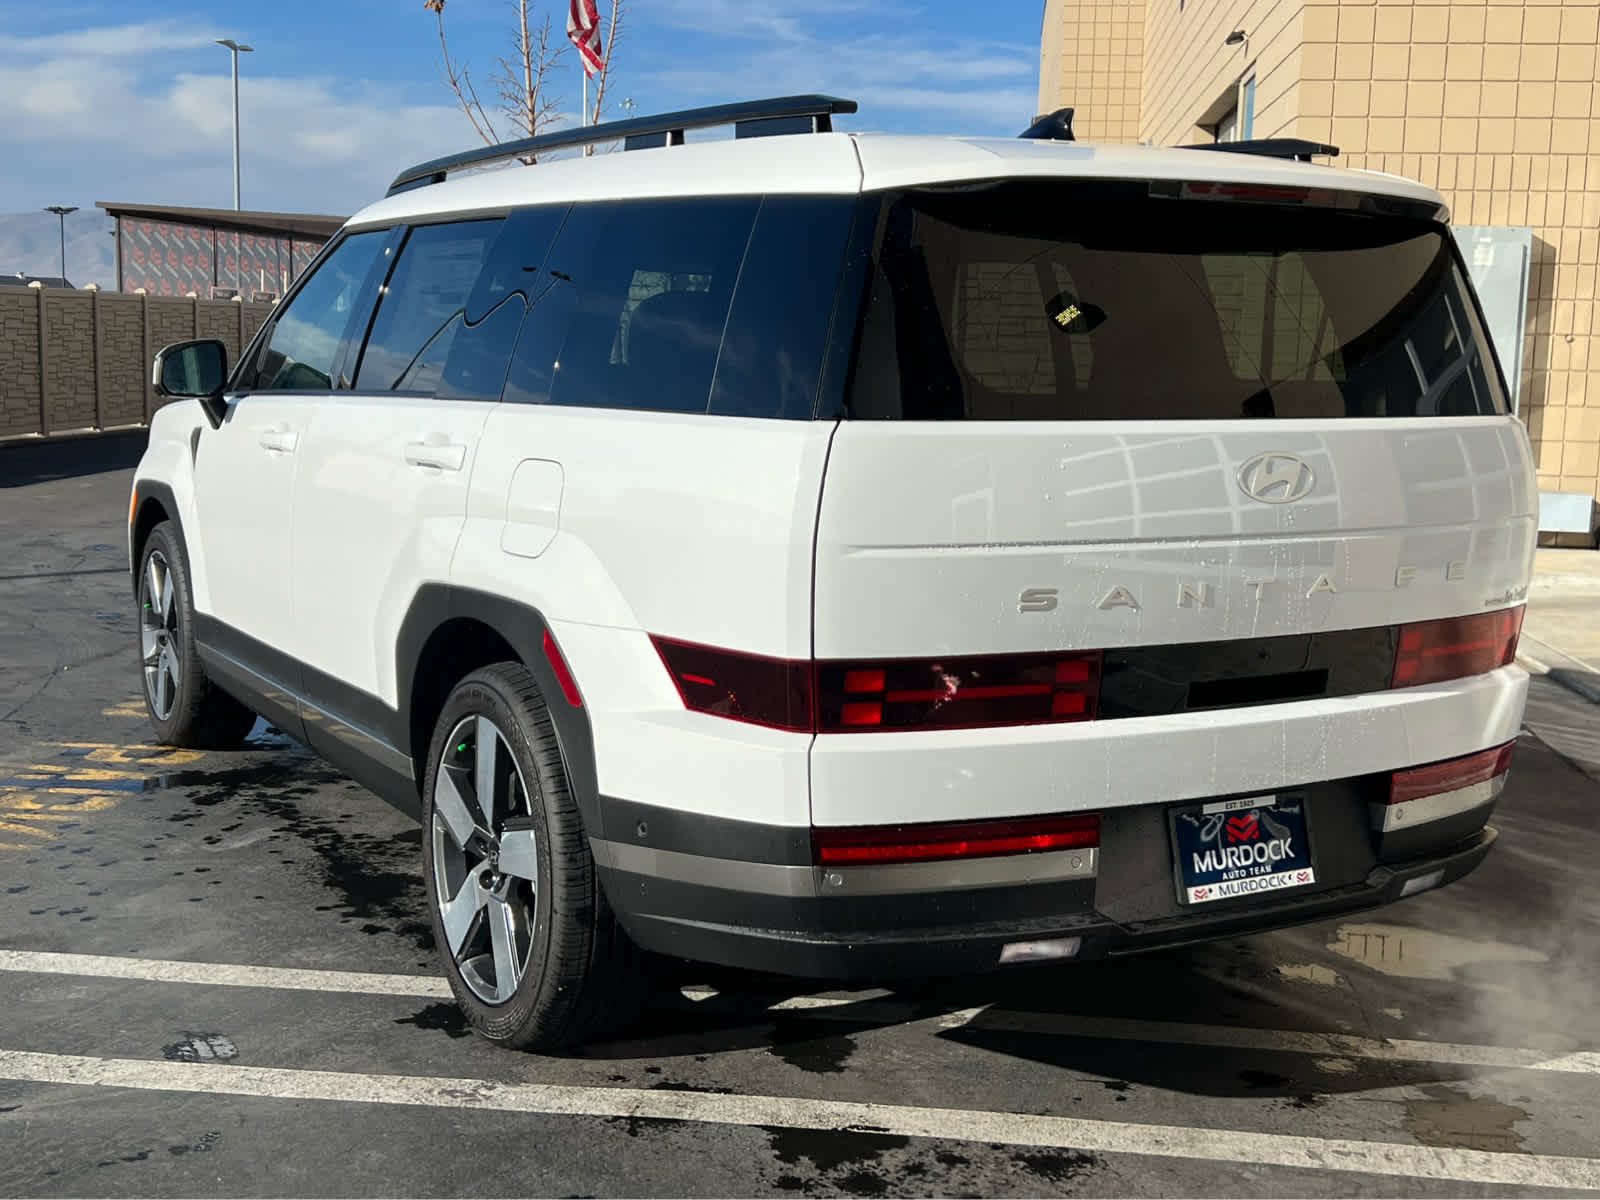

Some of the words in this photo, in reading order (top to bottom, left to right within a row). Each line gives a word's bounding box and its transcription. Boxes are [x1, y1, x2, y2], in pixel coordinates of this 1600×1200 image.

[1018, 574, 1337, 613] SANTA
[1394, 560, 1465, 588] FE
[1193, 838, 1295, 873] MURDOCK
[1218, 874, 1287, 897] MURDOCK
[1222, 869, 1247, 881] AUTO
[1249, 864, 1272, 876] TEAM
